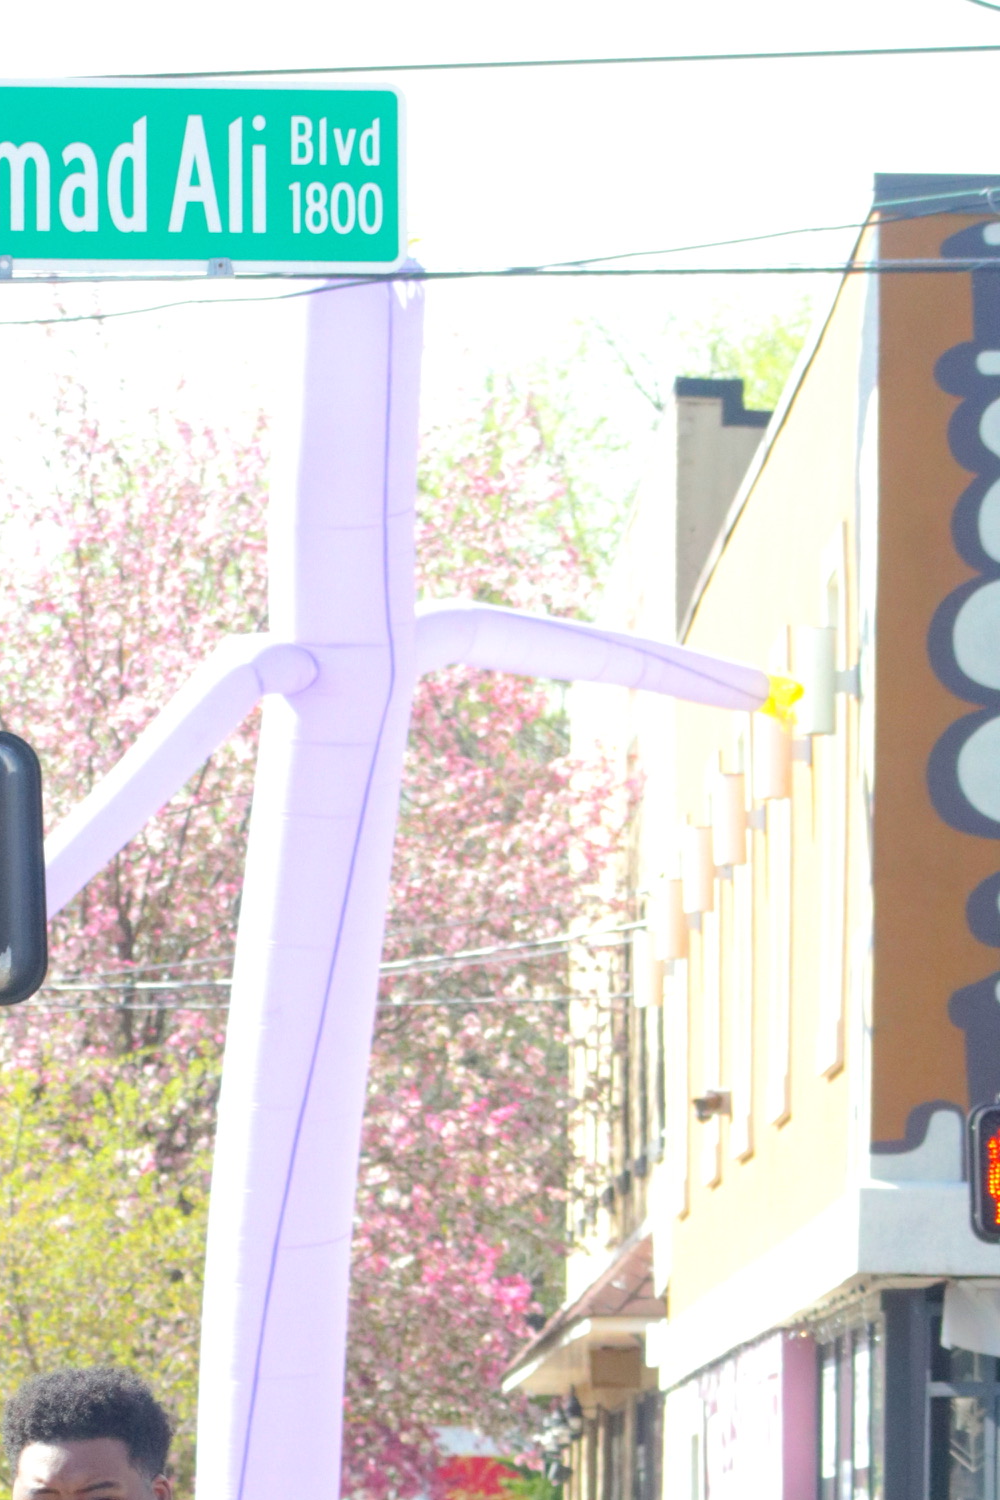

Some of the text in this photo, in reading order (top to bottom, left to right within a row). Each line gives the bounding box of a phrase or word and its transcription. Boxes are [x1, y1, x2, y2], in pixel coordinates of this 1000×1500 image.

[291, 115, 381, 166] Blvd
[168, 114, 267, 235] Ali
[288, 181, 384, 235] 1800
